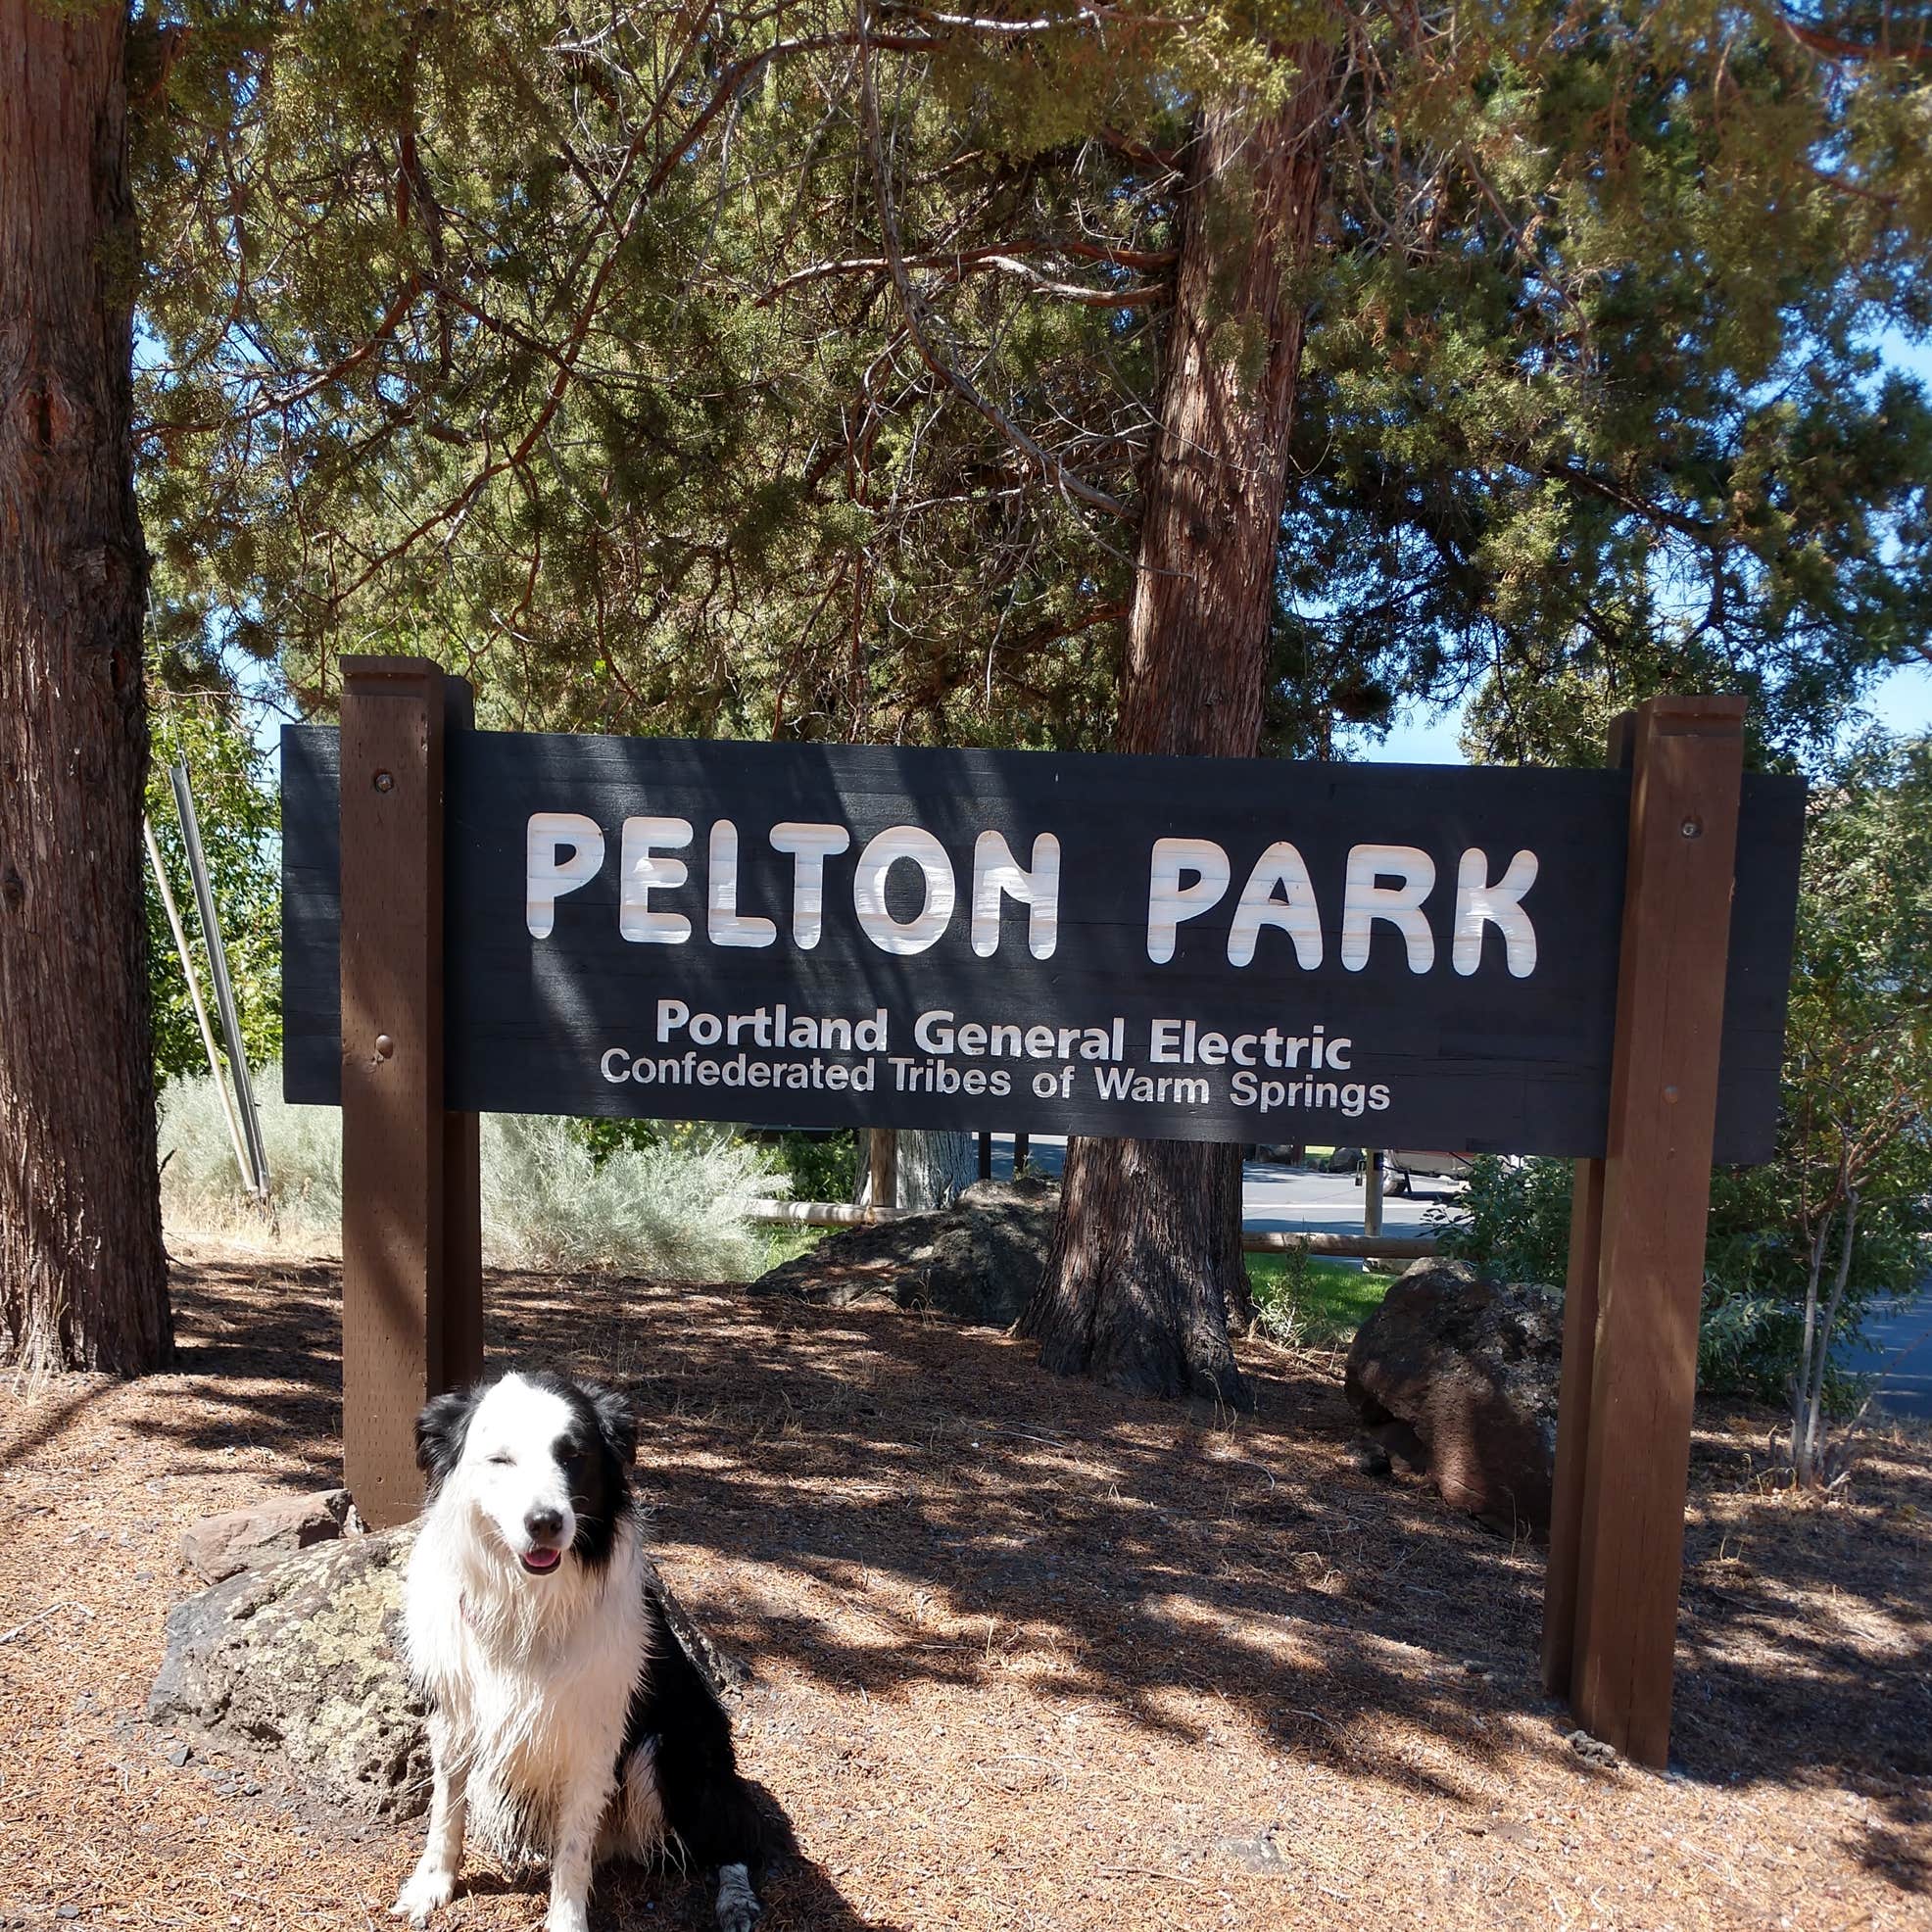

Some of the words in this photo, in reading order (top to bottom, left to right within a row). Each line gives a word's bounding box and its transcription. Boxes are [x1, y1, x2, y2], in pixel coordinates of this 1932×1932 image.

[526, 812, 1061, 960] PELTON
[1146, 837, 1539, 978] PARK
[655, 999, 889, 1052] Portland
[914, 1009, 1125, 1061] General
[1149, 1018, 1352, 1070] Electric
[601, 1047, 875, 1093] Confederated
[888, 1057, 1011, 1097] Tribes
[1032, 1065, 1076, 1099] of
[1093, 1066, 1211, 1106] Warm
[1229, 1071, 1390, 1117] Springs
